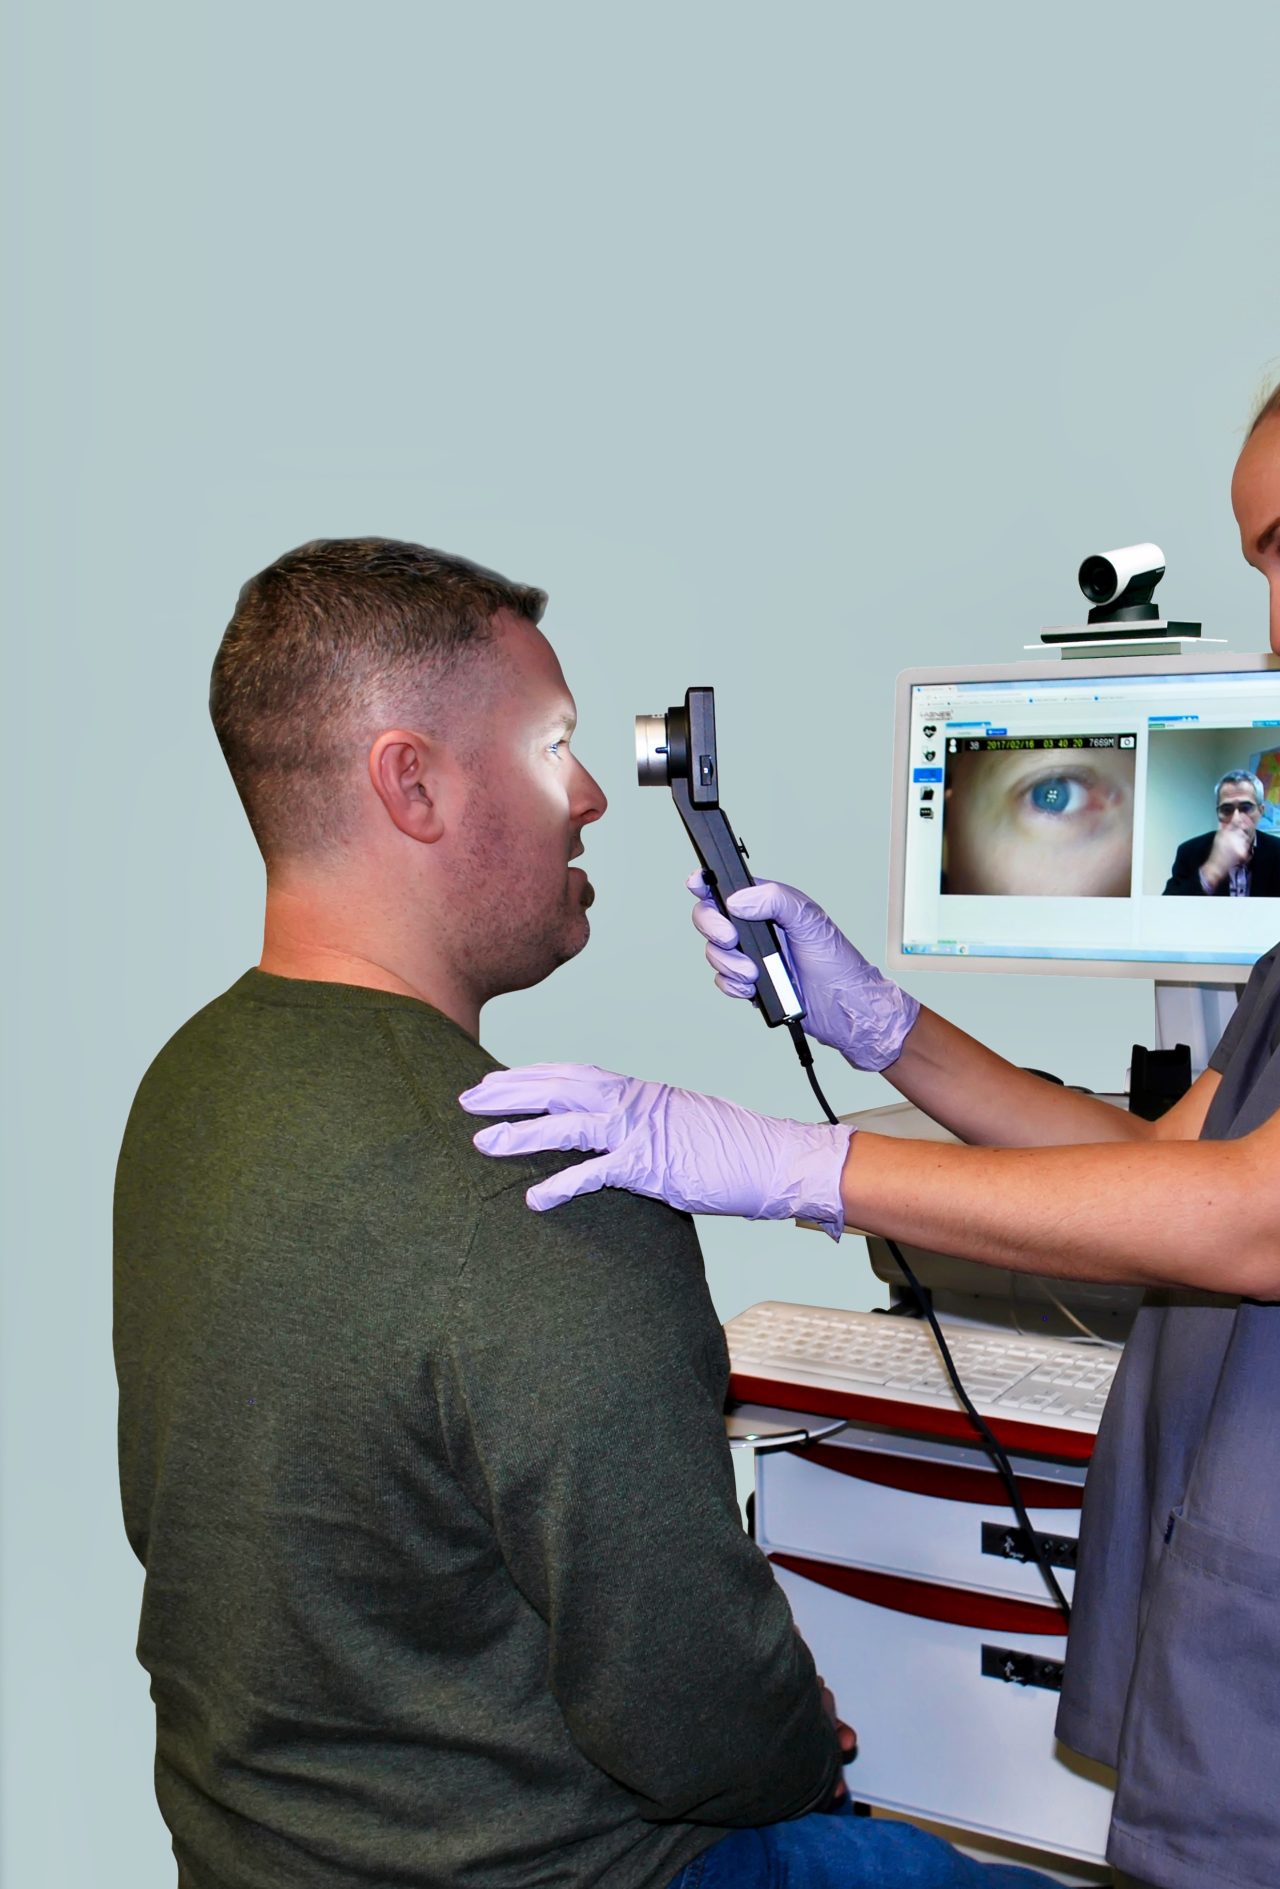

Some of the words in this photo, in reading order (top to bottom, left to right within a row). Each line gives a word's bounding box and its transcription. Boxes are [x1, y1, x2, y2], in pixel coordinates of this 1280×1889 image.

[987, 739, 1034, 750] 2017/02/16
[1058, 738, 1069, 749] 40
[1073, 738, 1083, 748] 20
